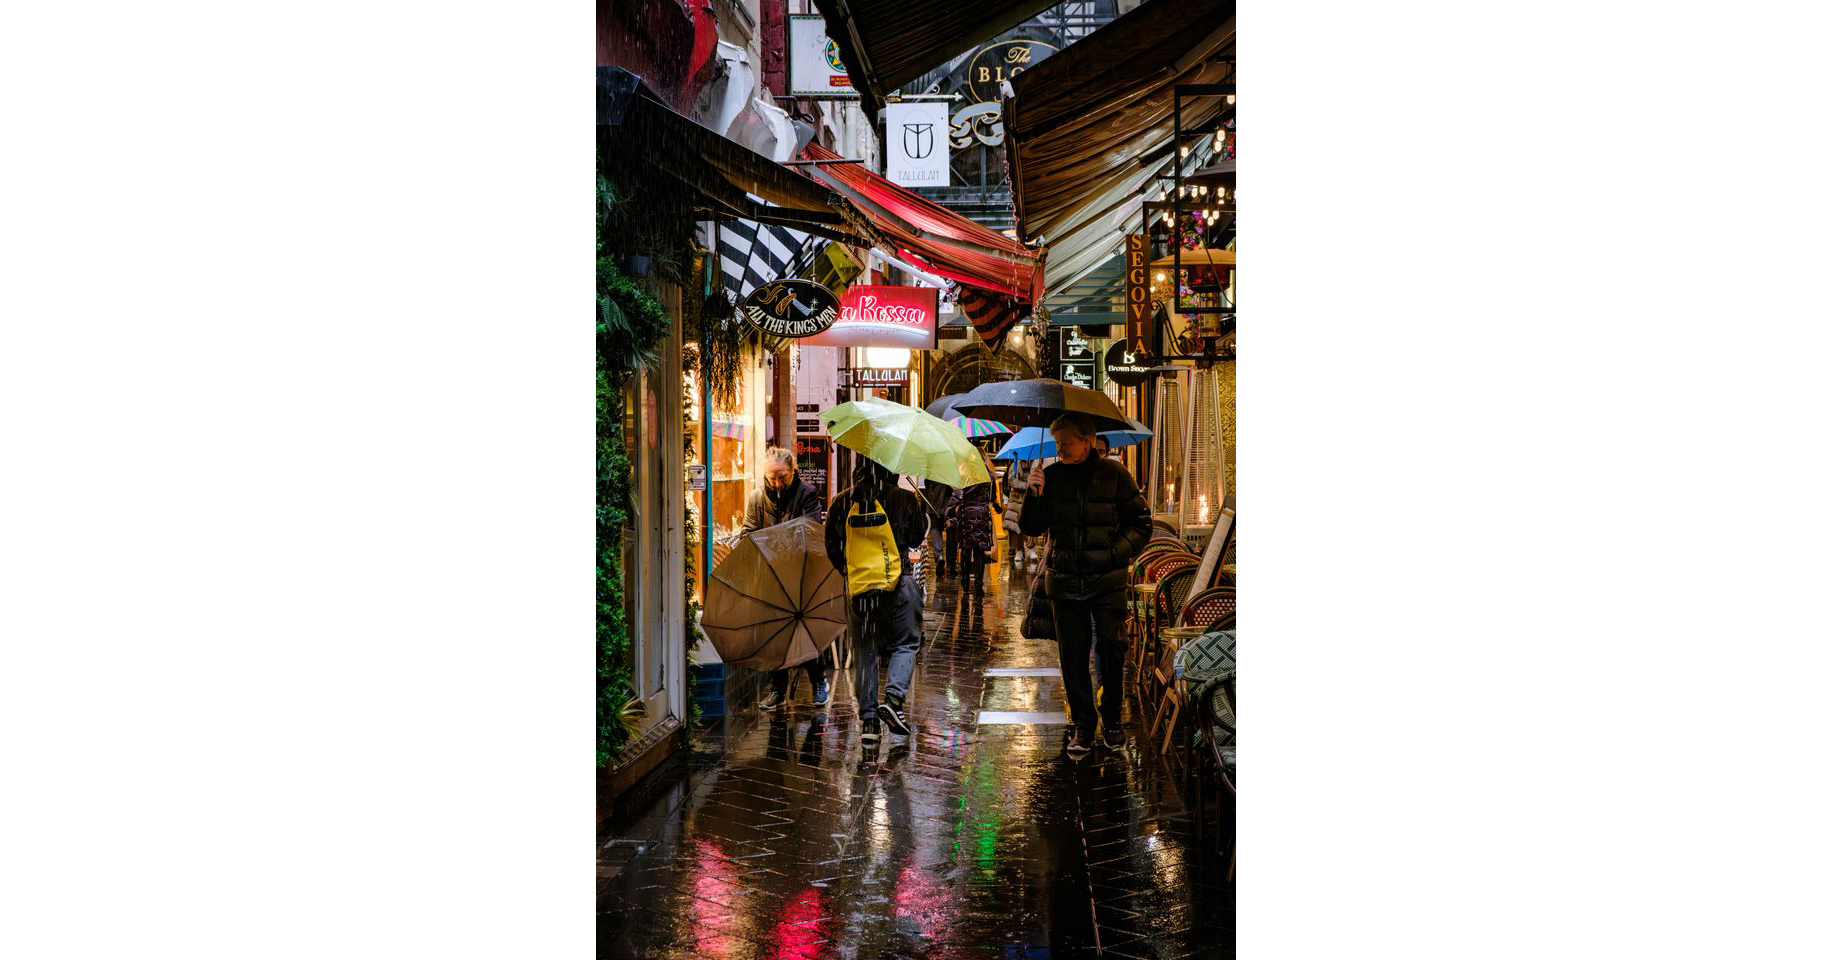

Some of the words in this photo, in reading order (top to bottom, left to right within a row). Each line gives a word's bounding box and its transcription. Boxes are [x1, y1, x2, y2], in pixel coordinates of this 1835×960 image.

[1004, 46, 1033, 63] The
[1130, 234, 1147, 354] SEGOVIA
[745, 304, 767, 325] ALL
[763, 314, 785, 334] THE
[785, 317, 818, 335] KINGS
[815, 305, 838, 328] MEN
[859, 295, 926, 324] Rossa
[1108, 364, 1130, 372] Brown
